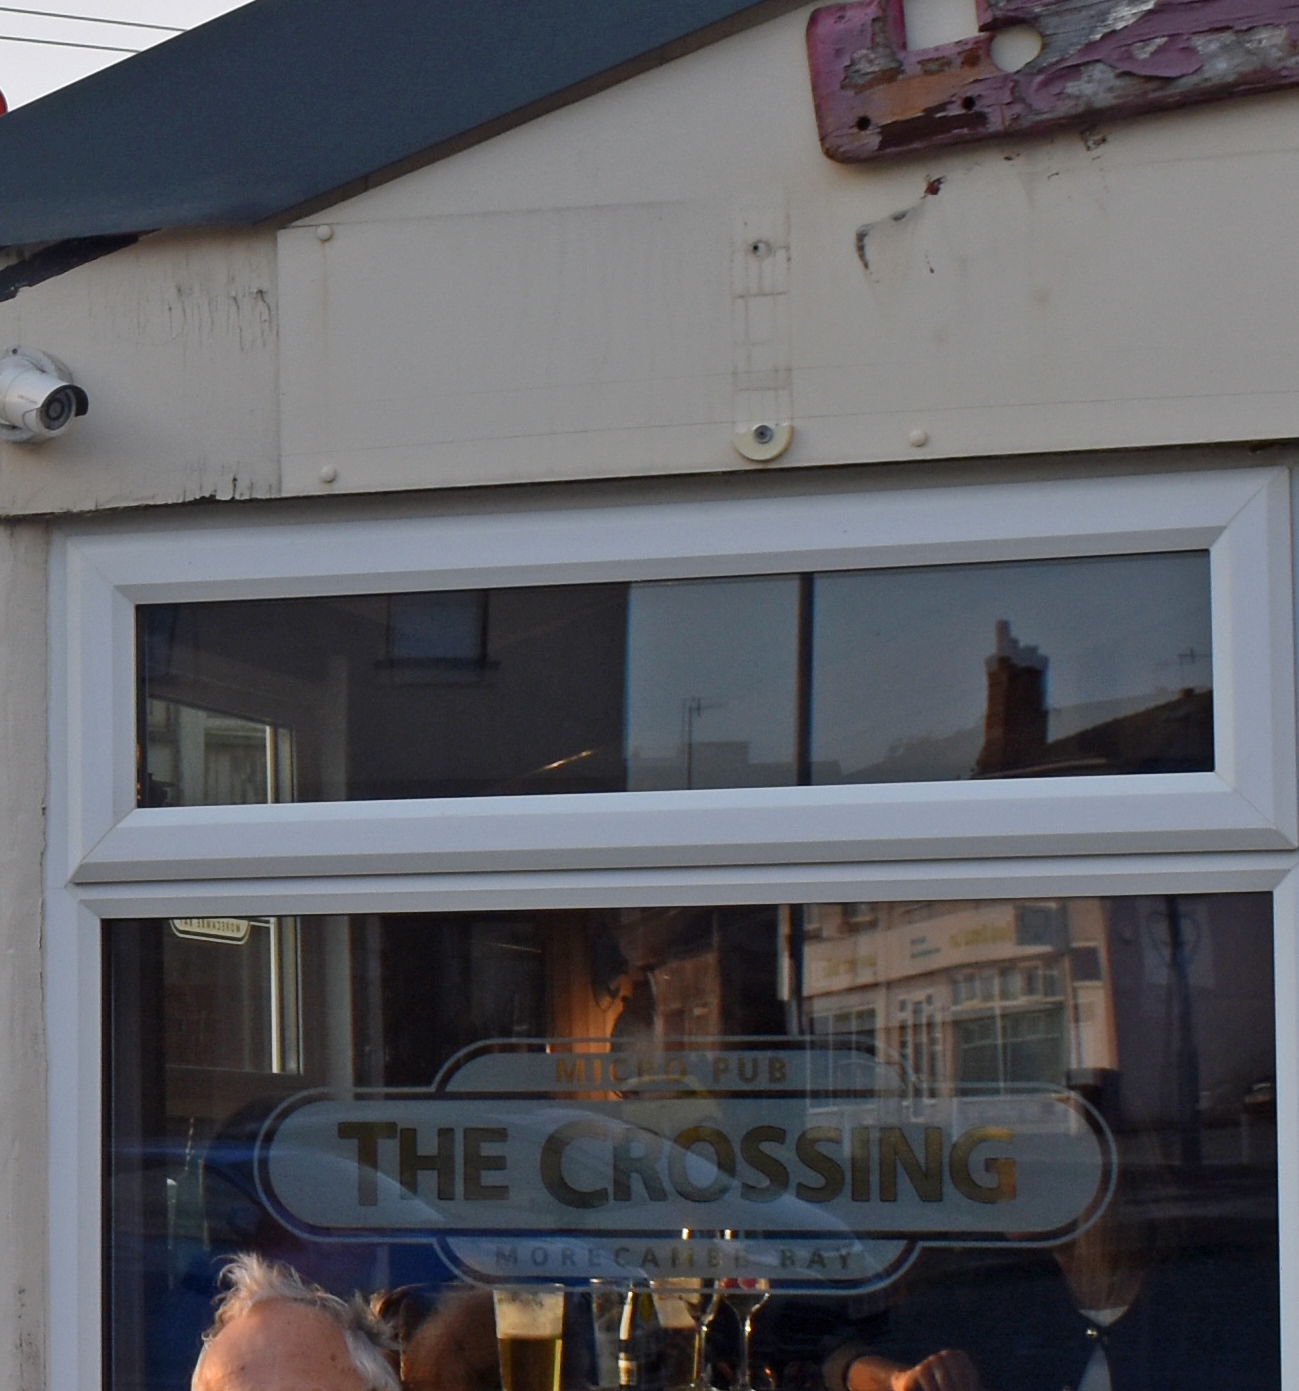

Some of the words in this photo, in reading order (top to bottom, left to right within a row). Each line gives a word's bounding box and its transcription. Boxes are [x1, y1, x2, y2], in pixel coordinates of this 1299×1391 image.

[556, 1056, 688, 1084] MICRO
[713, 1056, 788, 1084] PUB
[337, 1121, 509, 1207] THE
[540, 1120, 1017, 1208] CROSSING
[495, 1245, 748, 1270] MORECAMBE
[780, 1248, 853, 1270] BAY
